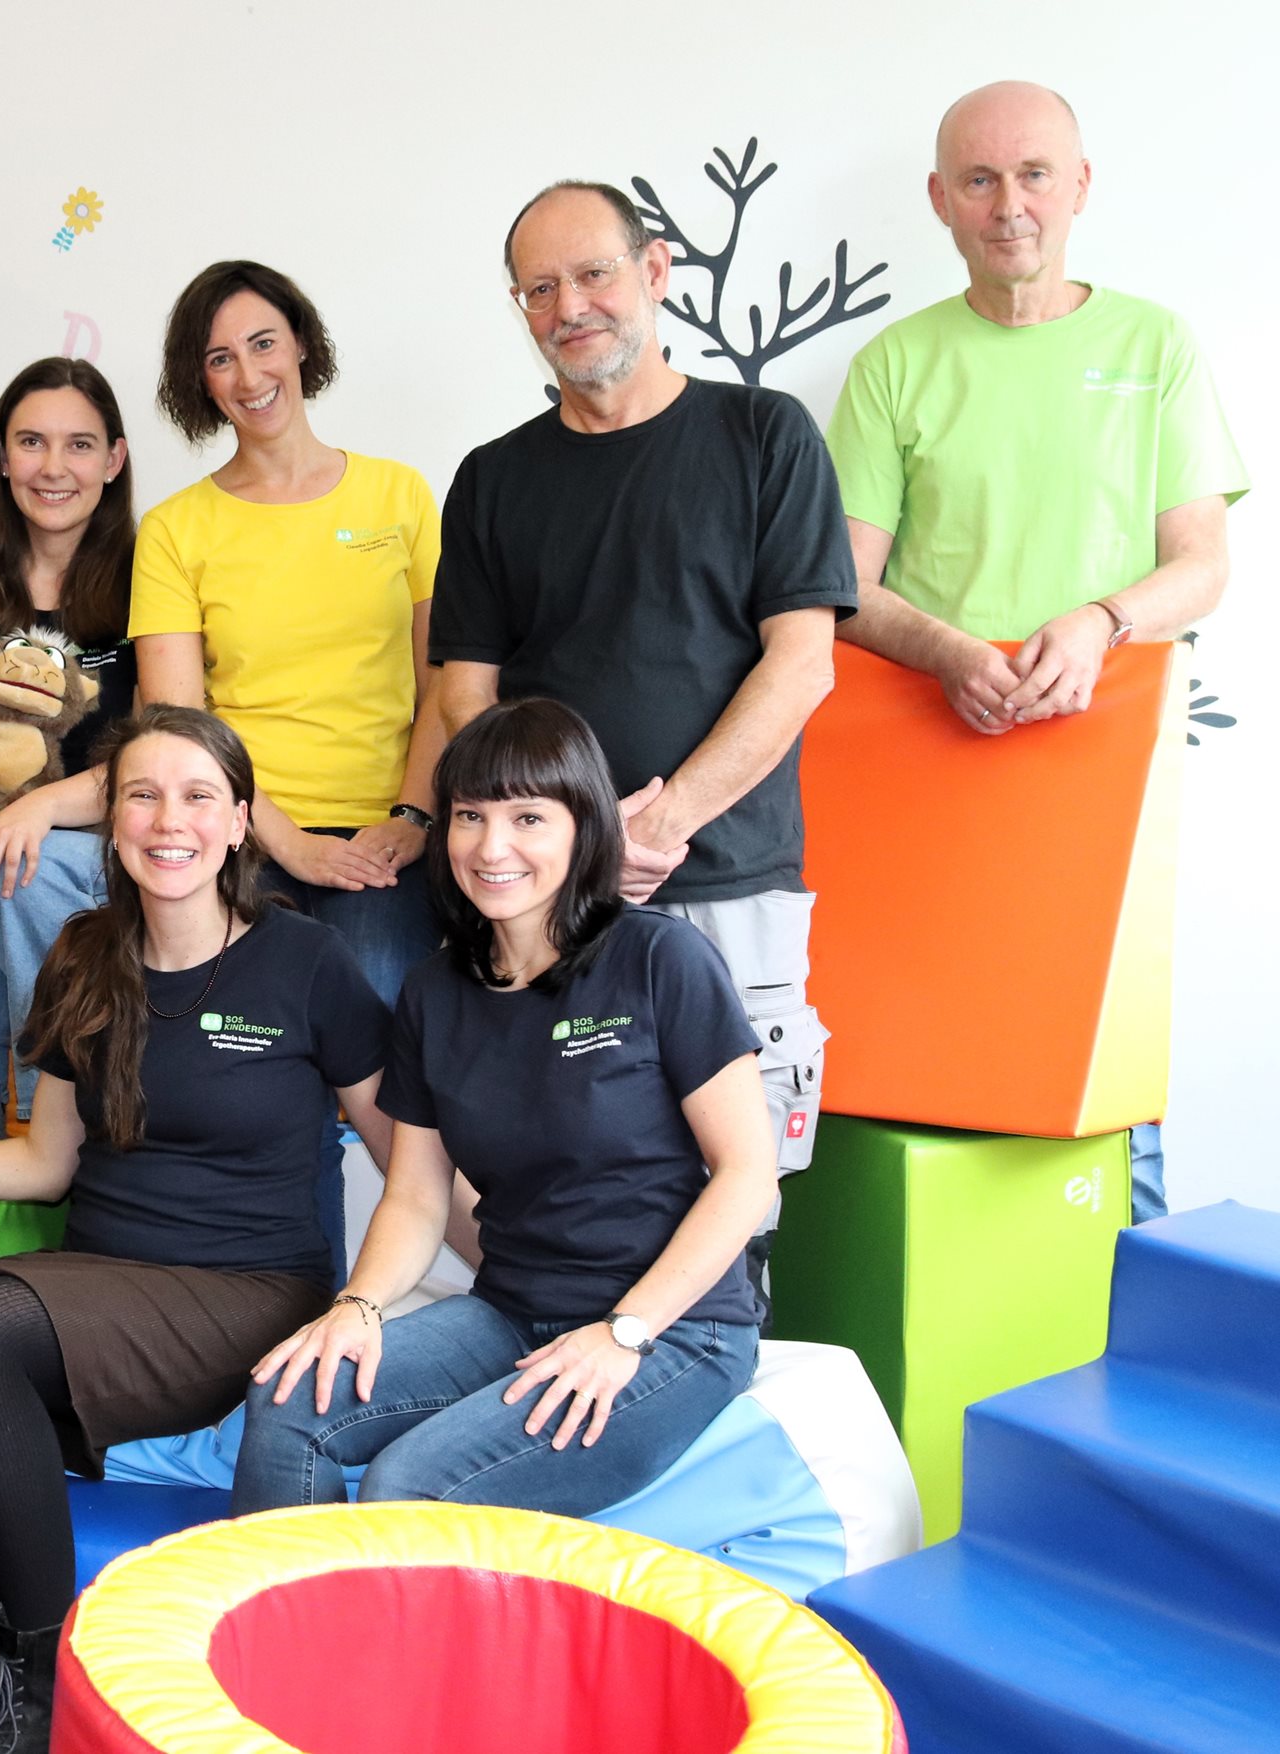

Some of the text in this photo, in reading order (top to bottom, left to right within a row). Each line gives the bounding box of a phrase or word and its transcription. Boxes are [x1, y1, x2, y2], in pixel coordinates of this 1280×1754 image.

[63, 309, 102, 365] D
[225, 1015, 244, 1024] SOS
[573, 1017, 594, 1027] SOS
[223, 1024, 284, 1037] KINDERDORF
[573, 1017, 633, 1036] KINDERDORF
[212, 1041, 264, 1052] Ergotherapeutin
[238, 1036, 272, 1047] Innerhofer
[561, 1038, 622, 1058] Psychotherapeutin
